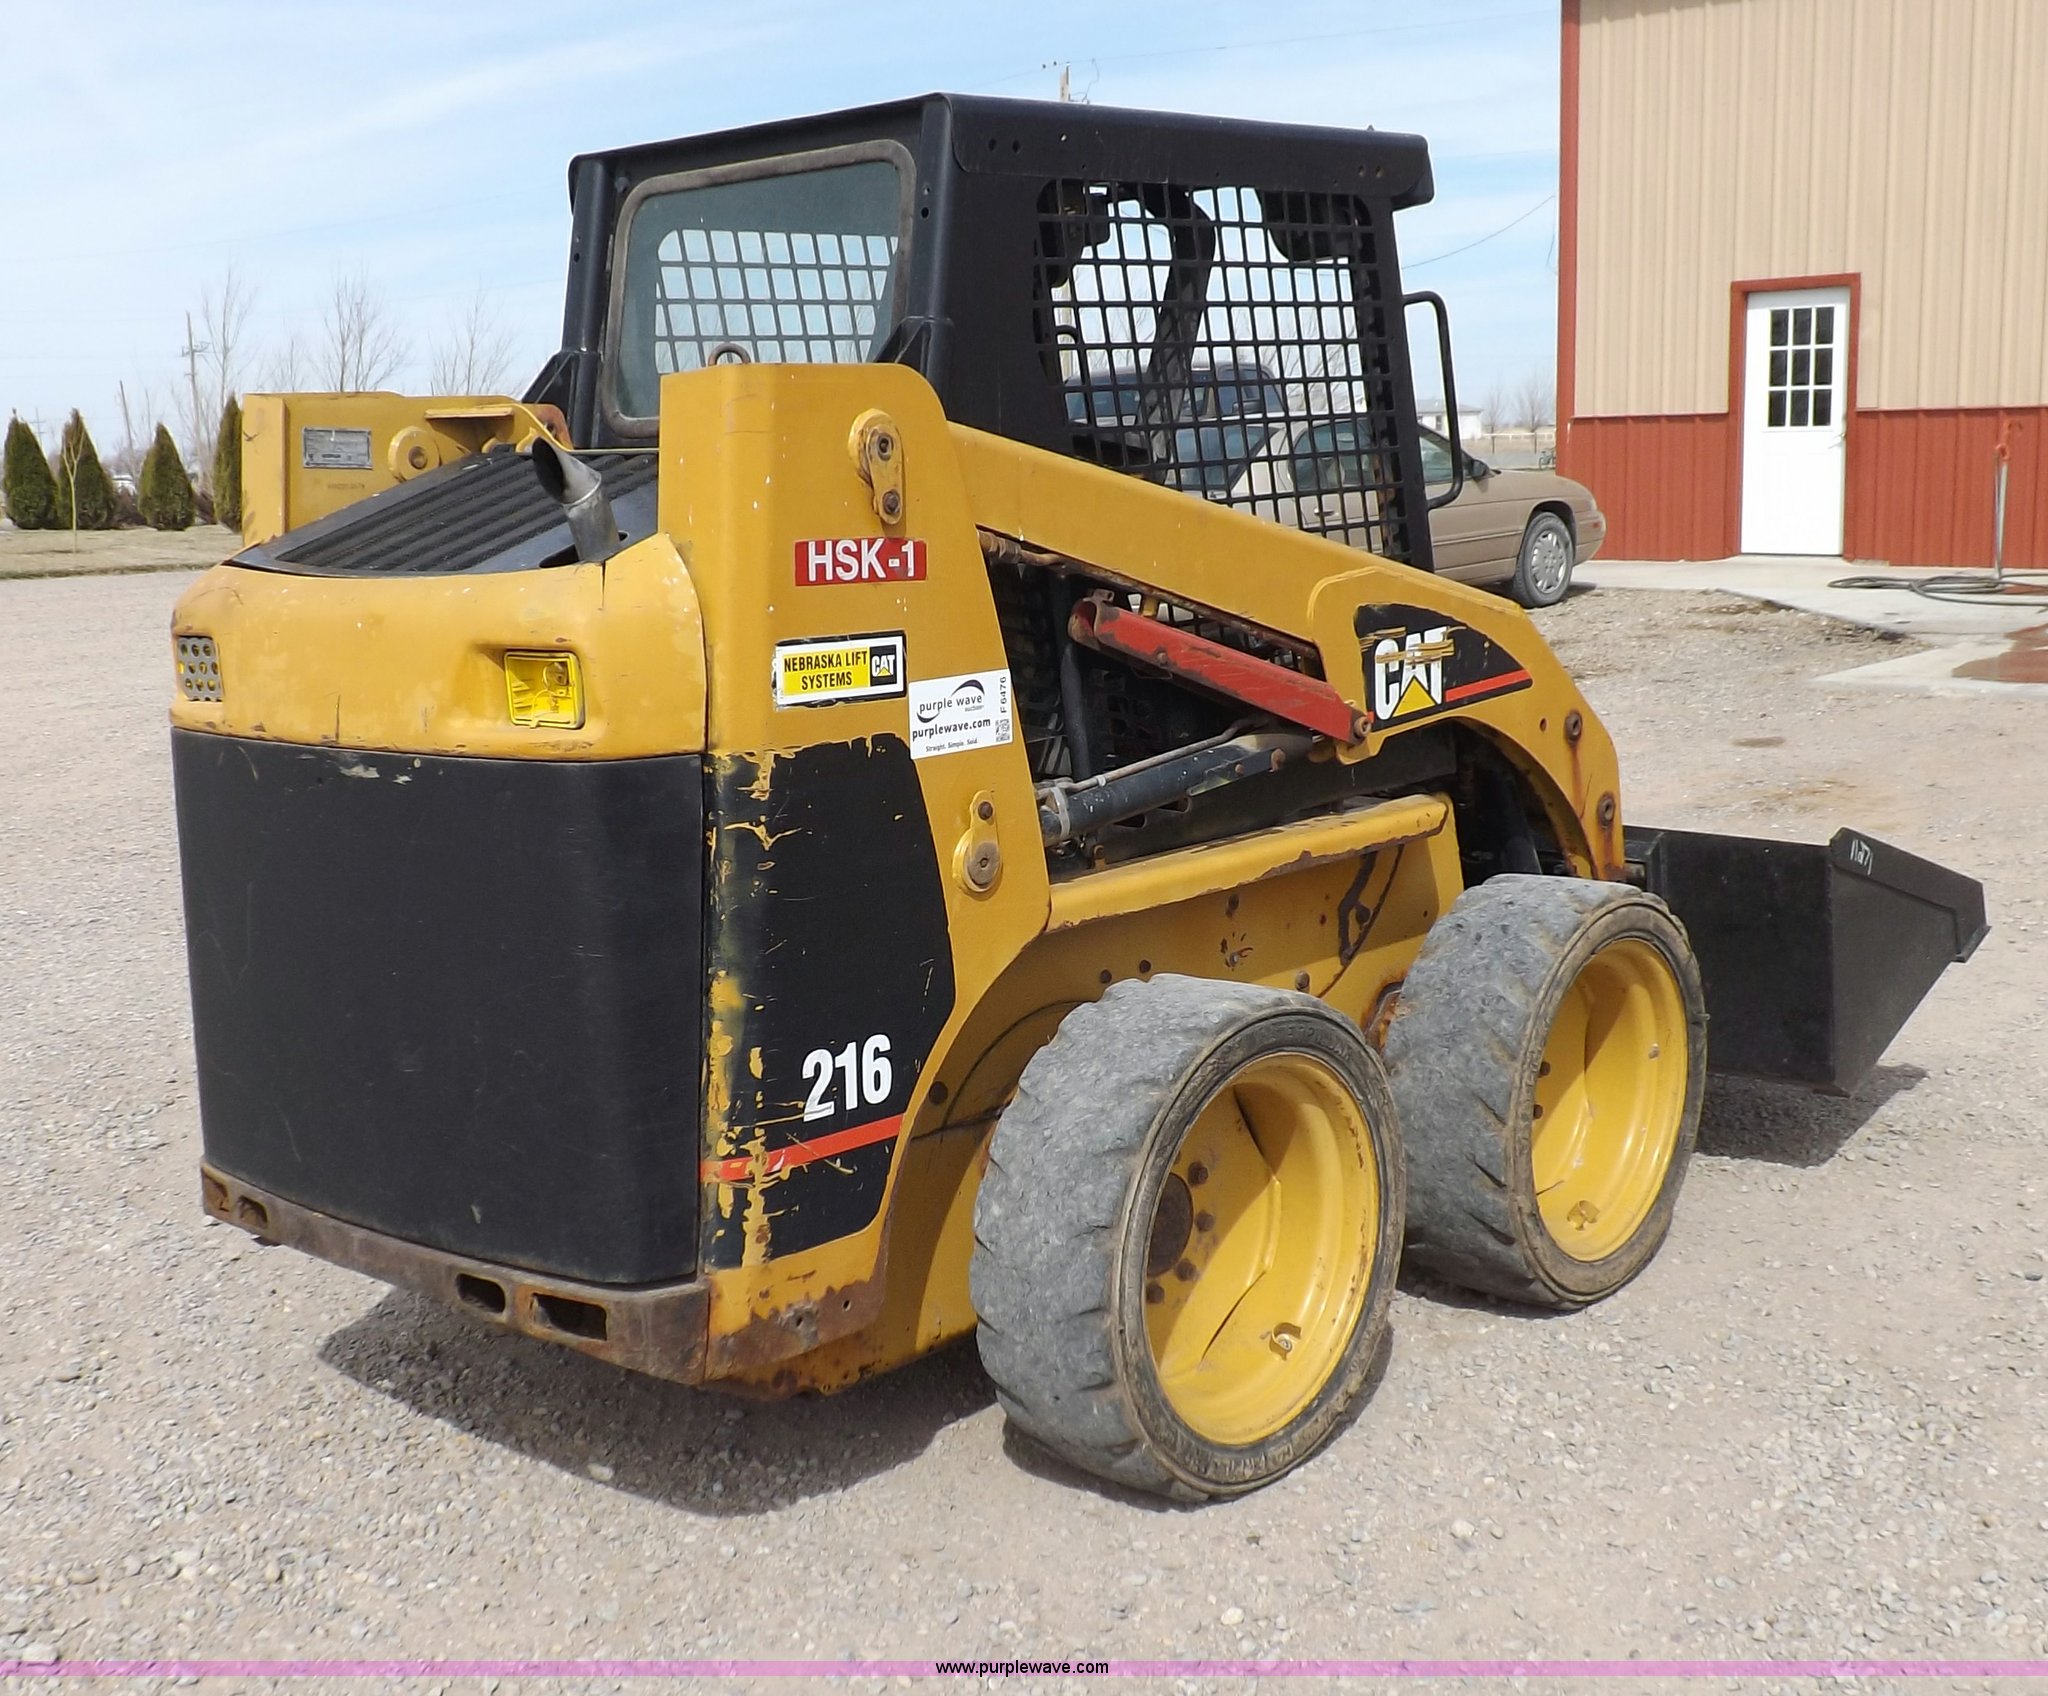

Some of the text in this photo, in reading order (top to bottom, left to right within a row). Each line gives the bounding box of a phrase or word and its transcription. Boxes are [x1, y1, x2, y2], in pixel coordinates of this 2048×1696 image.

[808, 538, 915, 582] HSK-1
[784, 651, 868, 673] NEBRASKA LIFT
[871, 654, 896, 677] CAT
[1375, 626, 1449, 720] CAT
[801, 671, 852, 690] SYSTEMS
[919, 695, 982, 714] purple wave
[912, 719, 991, 742] purplewave.com
[802, 1034, 892, 1122] 216
